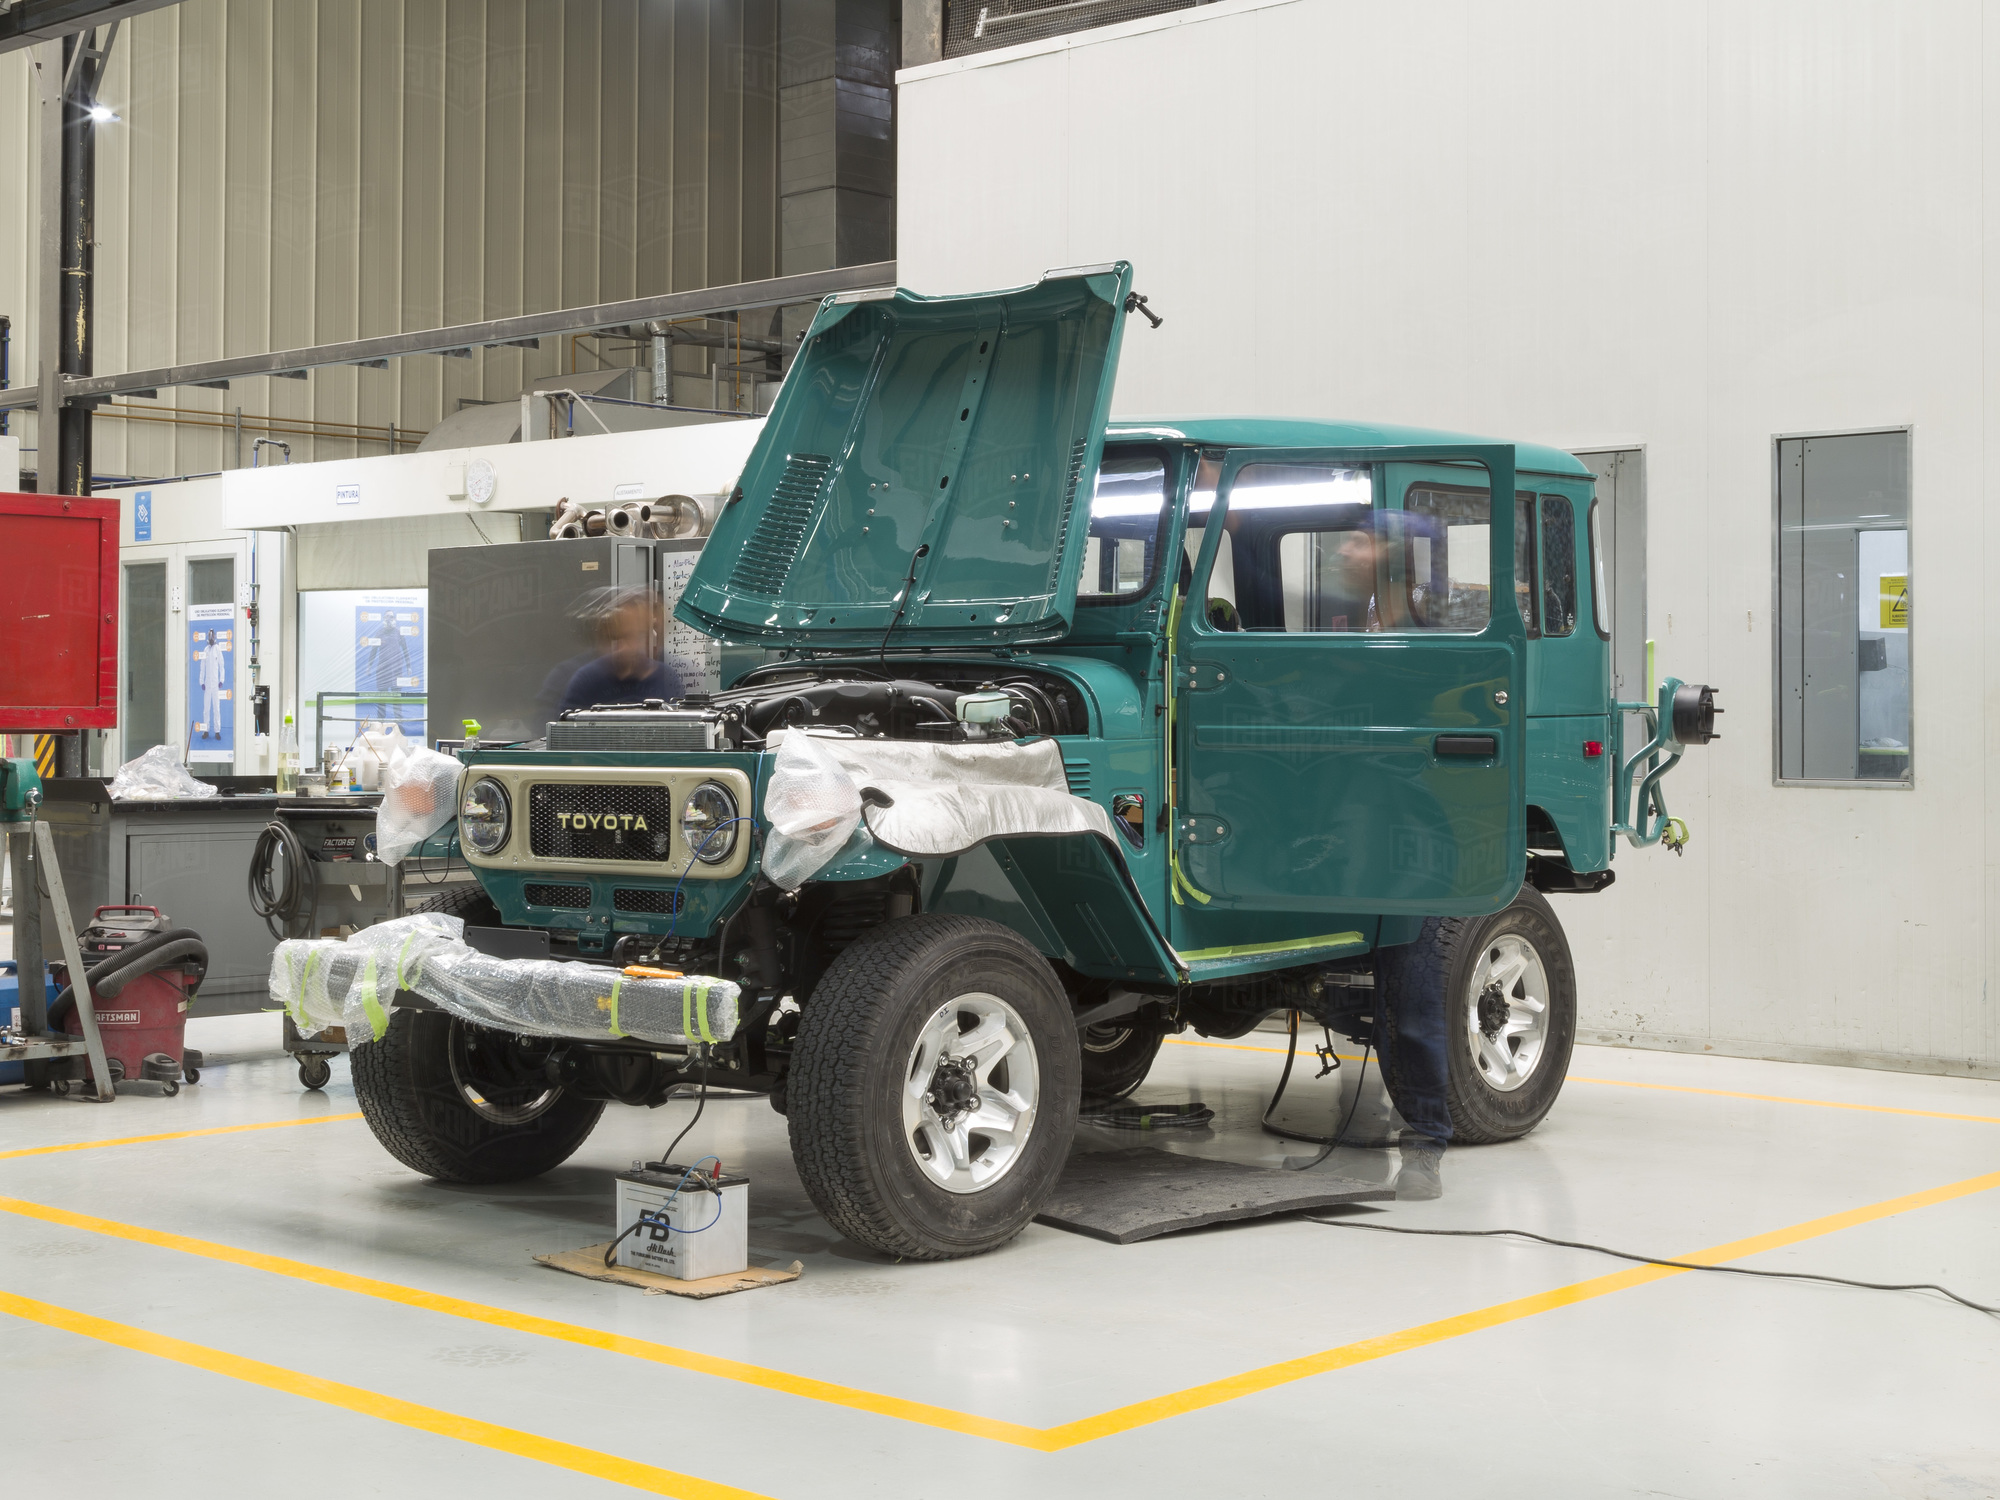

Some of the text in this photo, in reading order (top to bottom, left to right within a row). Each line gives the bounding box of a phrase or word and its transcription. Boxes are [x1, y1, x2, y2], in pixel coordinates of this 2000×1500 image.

[337, 490, 359, 498] PINTURA
[557, 813, 648, 831] TOYOTA
[323, 838, 357, 847] FACTOR 55
[635, 1209, 670, 1242] FB
